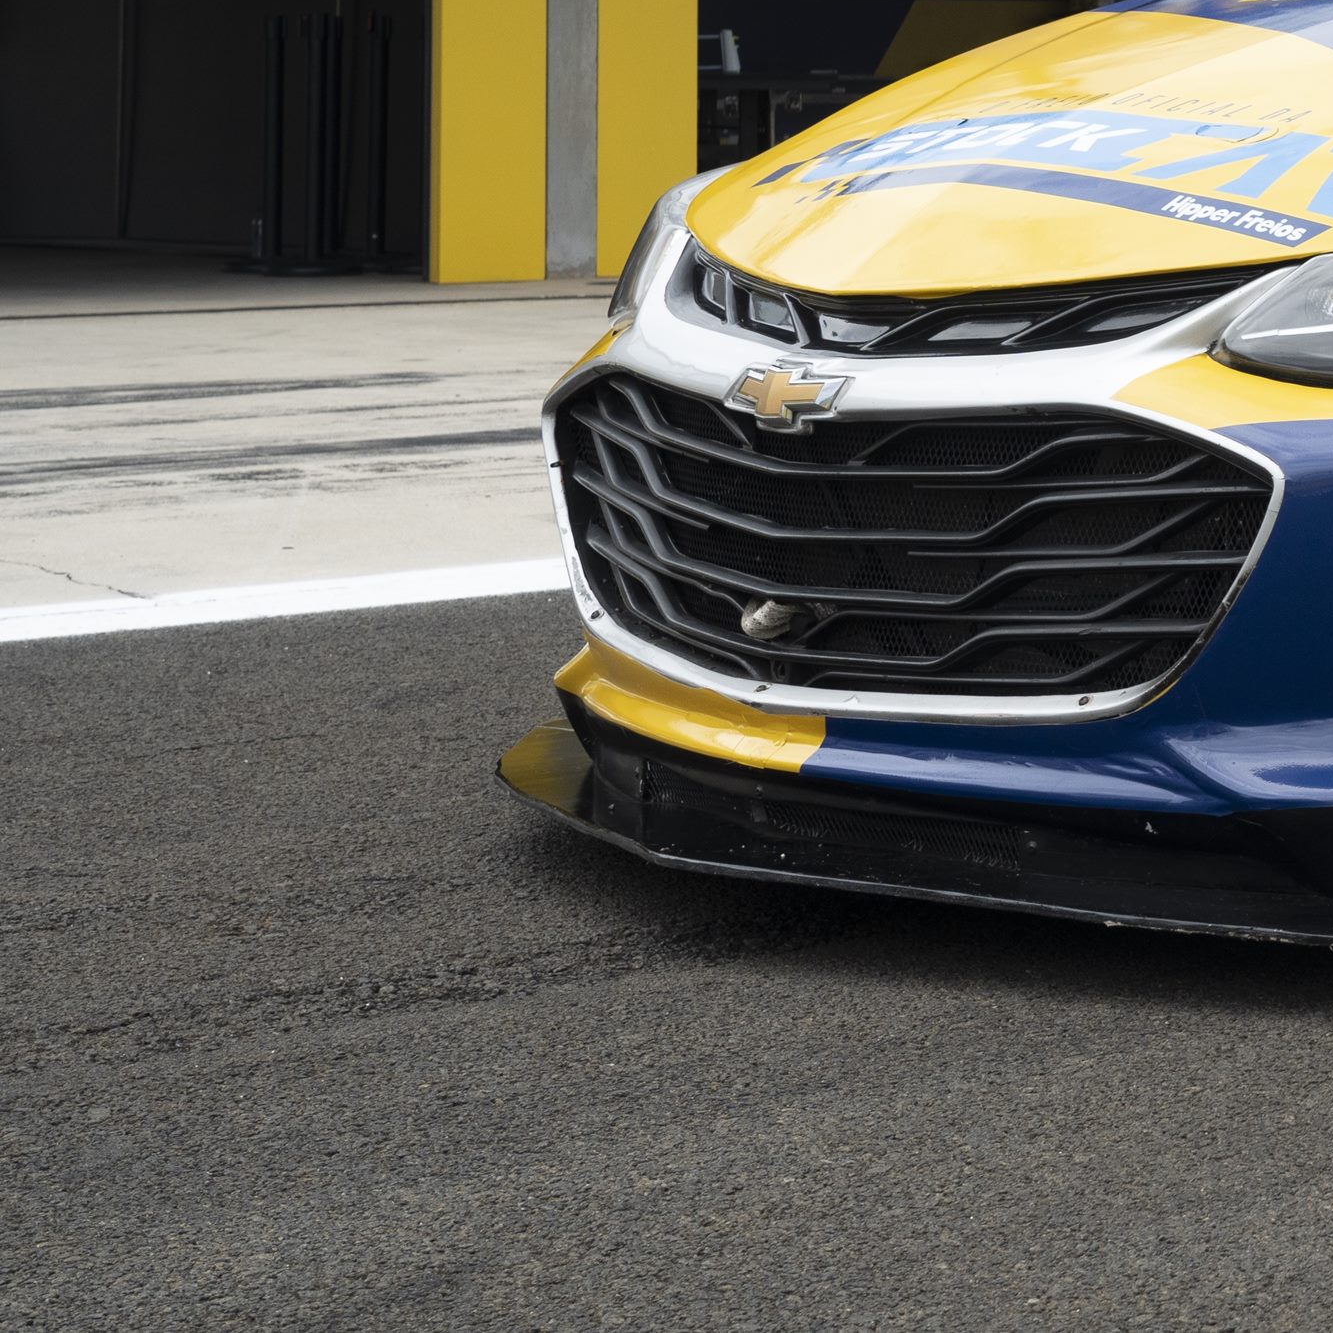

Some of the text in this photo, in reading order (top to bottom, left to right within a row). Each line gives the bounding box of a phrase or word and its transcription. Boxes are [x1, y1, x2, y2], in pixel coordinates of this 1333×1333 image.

[1112, 93, 1252, 118] OFICIAL
[1259, 109, 1313, 125] DA
[846, 122, 1147, 163] STOCK
[1161, 195, 1307, 241] Hipper Freios
